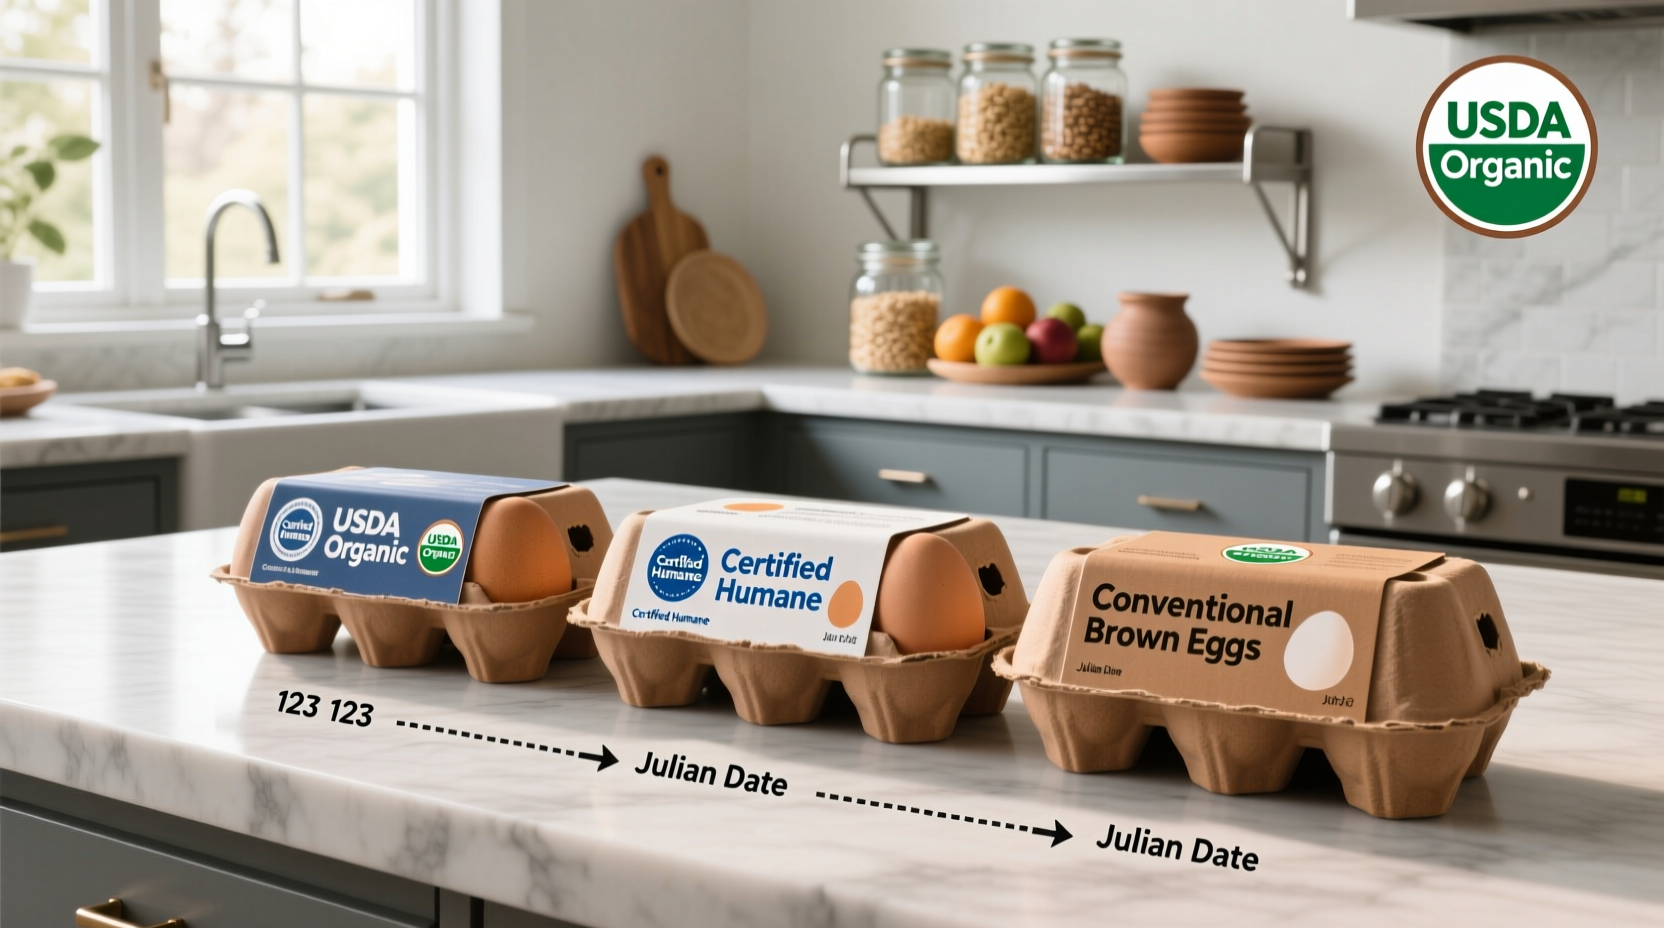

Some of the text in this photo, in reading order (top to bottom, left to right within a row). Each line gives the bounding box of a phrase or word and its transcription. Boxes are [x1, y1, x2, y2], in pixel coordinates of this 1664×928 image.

[332, 506, 400, 538] USDA
[324, 534, 409, 567] Organic
[721, 547, 834, 581] Certified
[714, 577, 823, 611] Humane
[1092, 582, 1294, 628] Conventional
[1083, 616, 1262, 666] Brown Eggs
